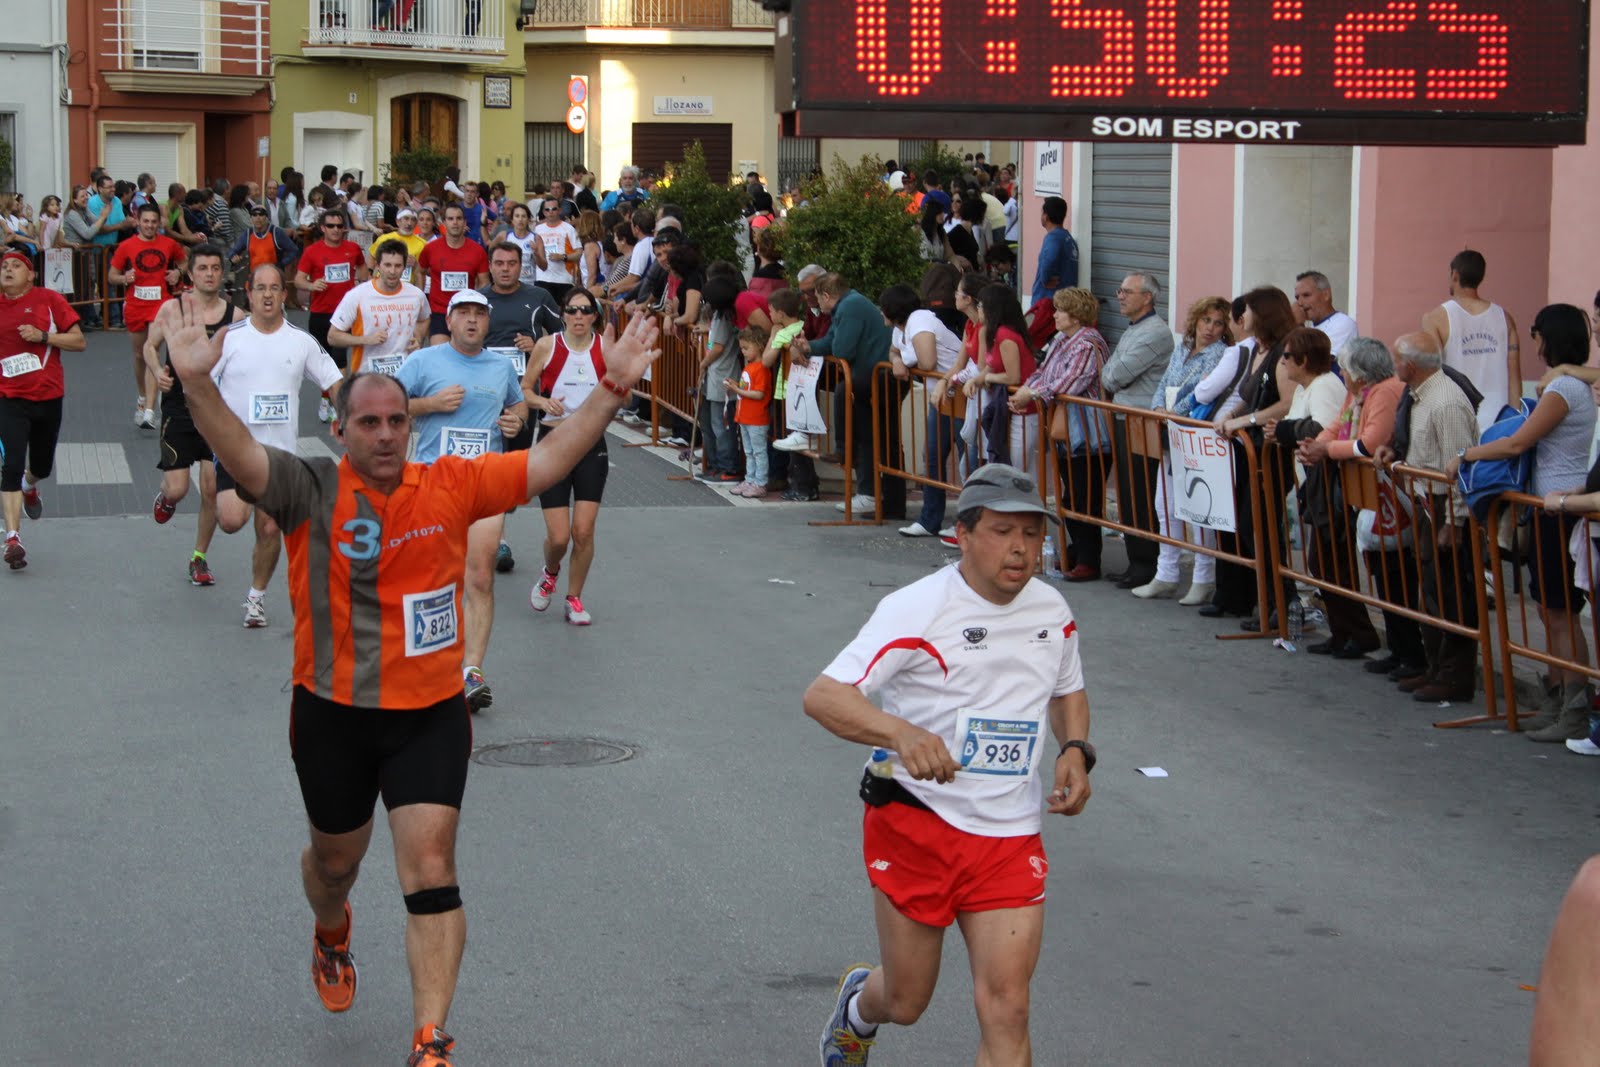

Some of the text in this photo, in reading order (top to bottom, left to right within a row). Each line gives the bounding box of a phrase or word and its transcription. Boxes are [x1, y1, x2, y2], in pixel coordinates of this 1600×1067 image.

[1092, 116, 1301, 140] SOM ESPORT
[1040, 149, 1058, 171] preu
[265, 405, 284, 416] 724
[460, 444, 481, 455] 573
[1170, 428, 1227, 457] MATTIES
[338, 518, 381, 560] 3
[416, 612, 451, 637] A 822
[964, 741, 1021, 763] B 936
